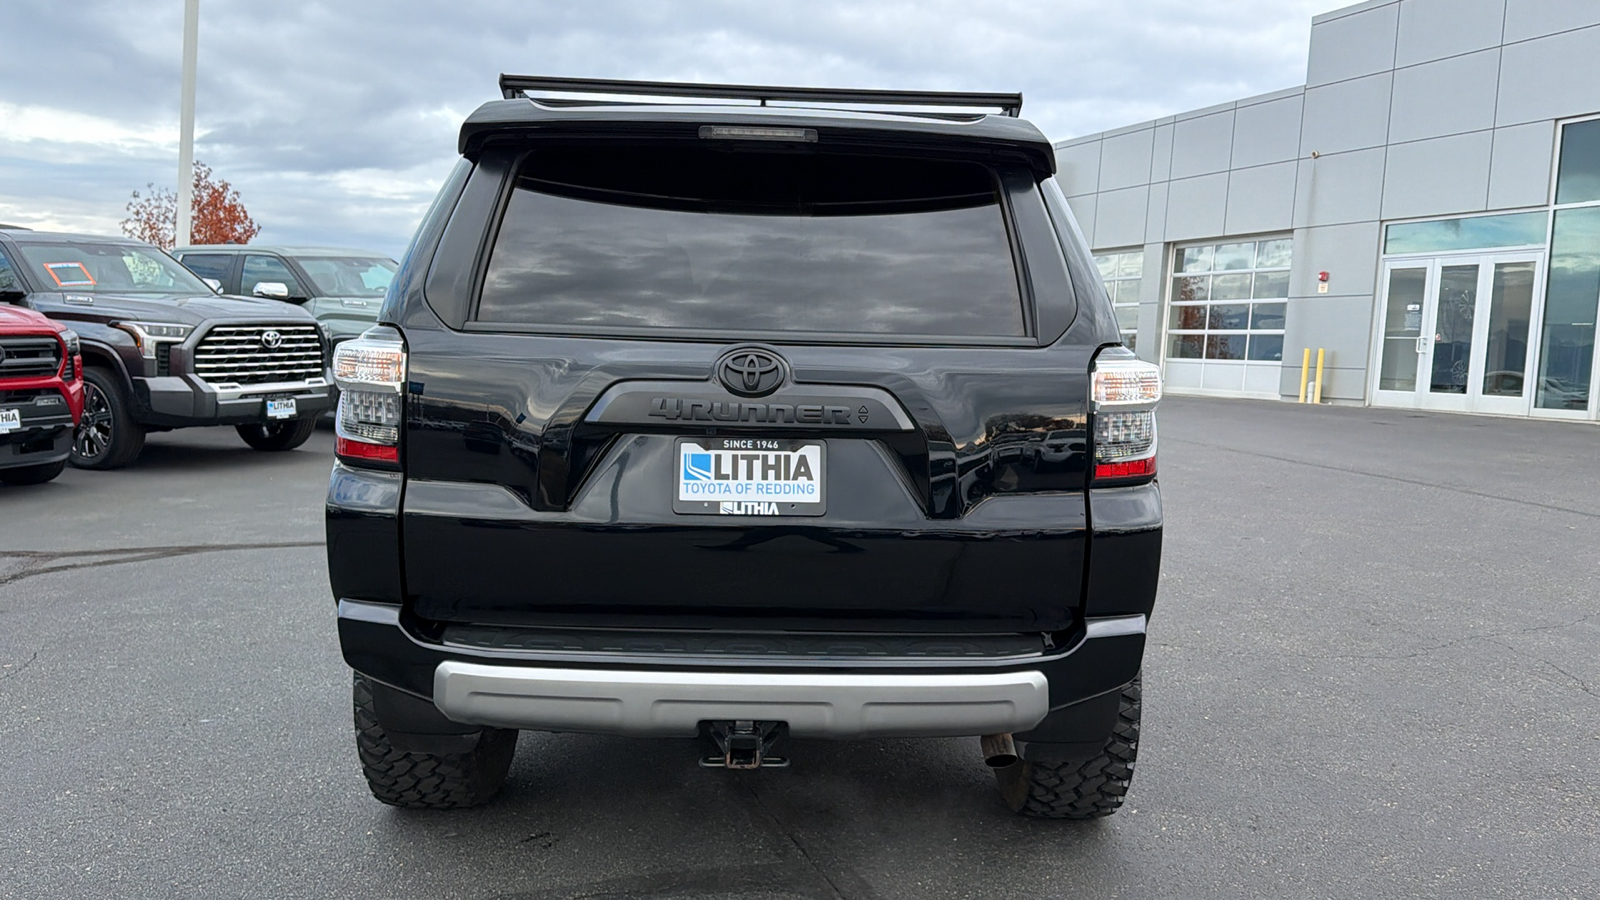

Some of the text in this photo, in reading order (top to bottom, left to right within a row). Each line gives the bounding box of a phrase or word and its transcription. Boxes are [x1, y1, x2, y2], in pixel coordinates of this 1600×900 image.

[273, 401, 295, 410] LITHIA
[0, 412, 18, 422] HIA
[723, 439, 779, 449] SINCE 1946
[714, 453, 814, 482] LITHIA
[683, 482, 815, 495] TOYOTA OF REDDING
[733, 501, 780, 516] LITHIA
